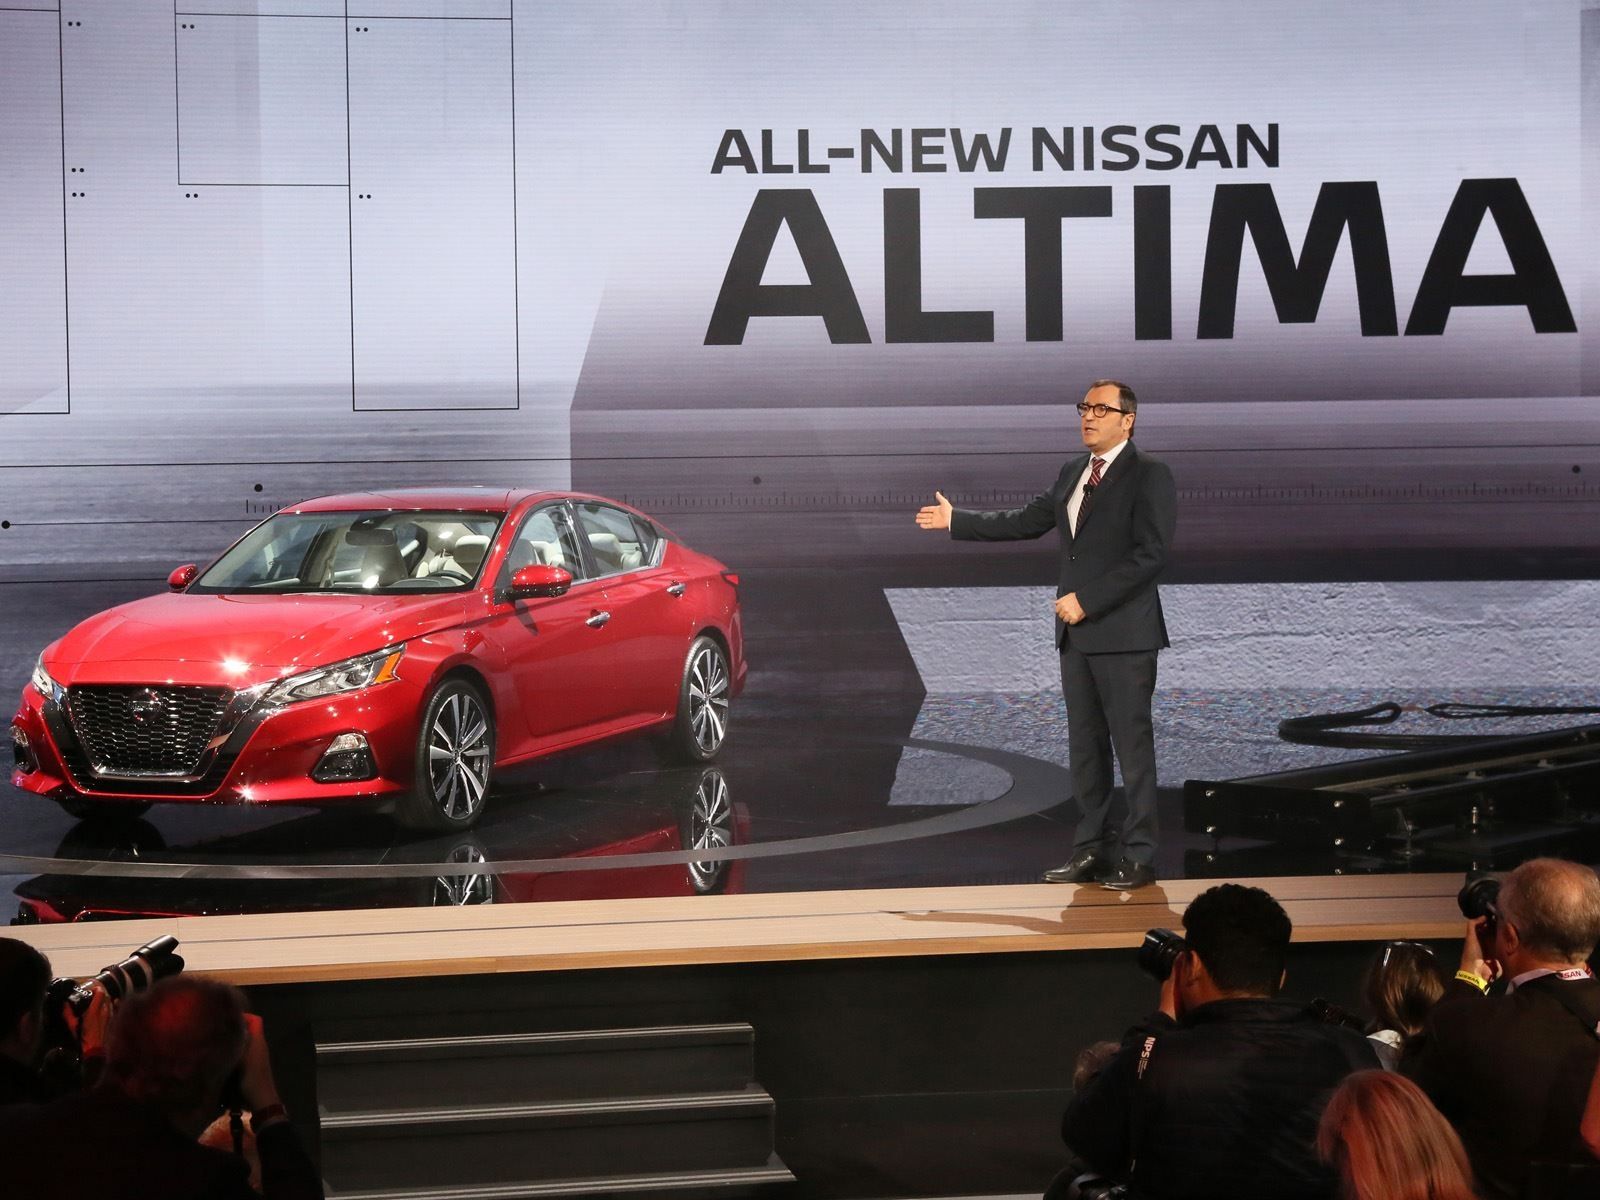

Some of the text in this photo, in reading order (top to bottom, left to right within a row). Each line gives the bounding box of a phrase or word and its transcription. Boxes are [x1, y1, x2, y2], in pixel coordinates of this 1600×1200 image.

[711, 123, 1280, 174] ALL-NEW NISSAN
[704, 178, 1578, 346] ALTIMA
[1141, 1036, 1156, 1058] NPS
